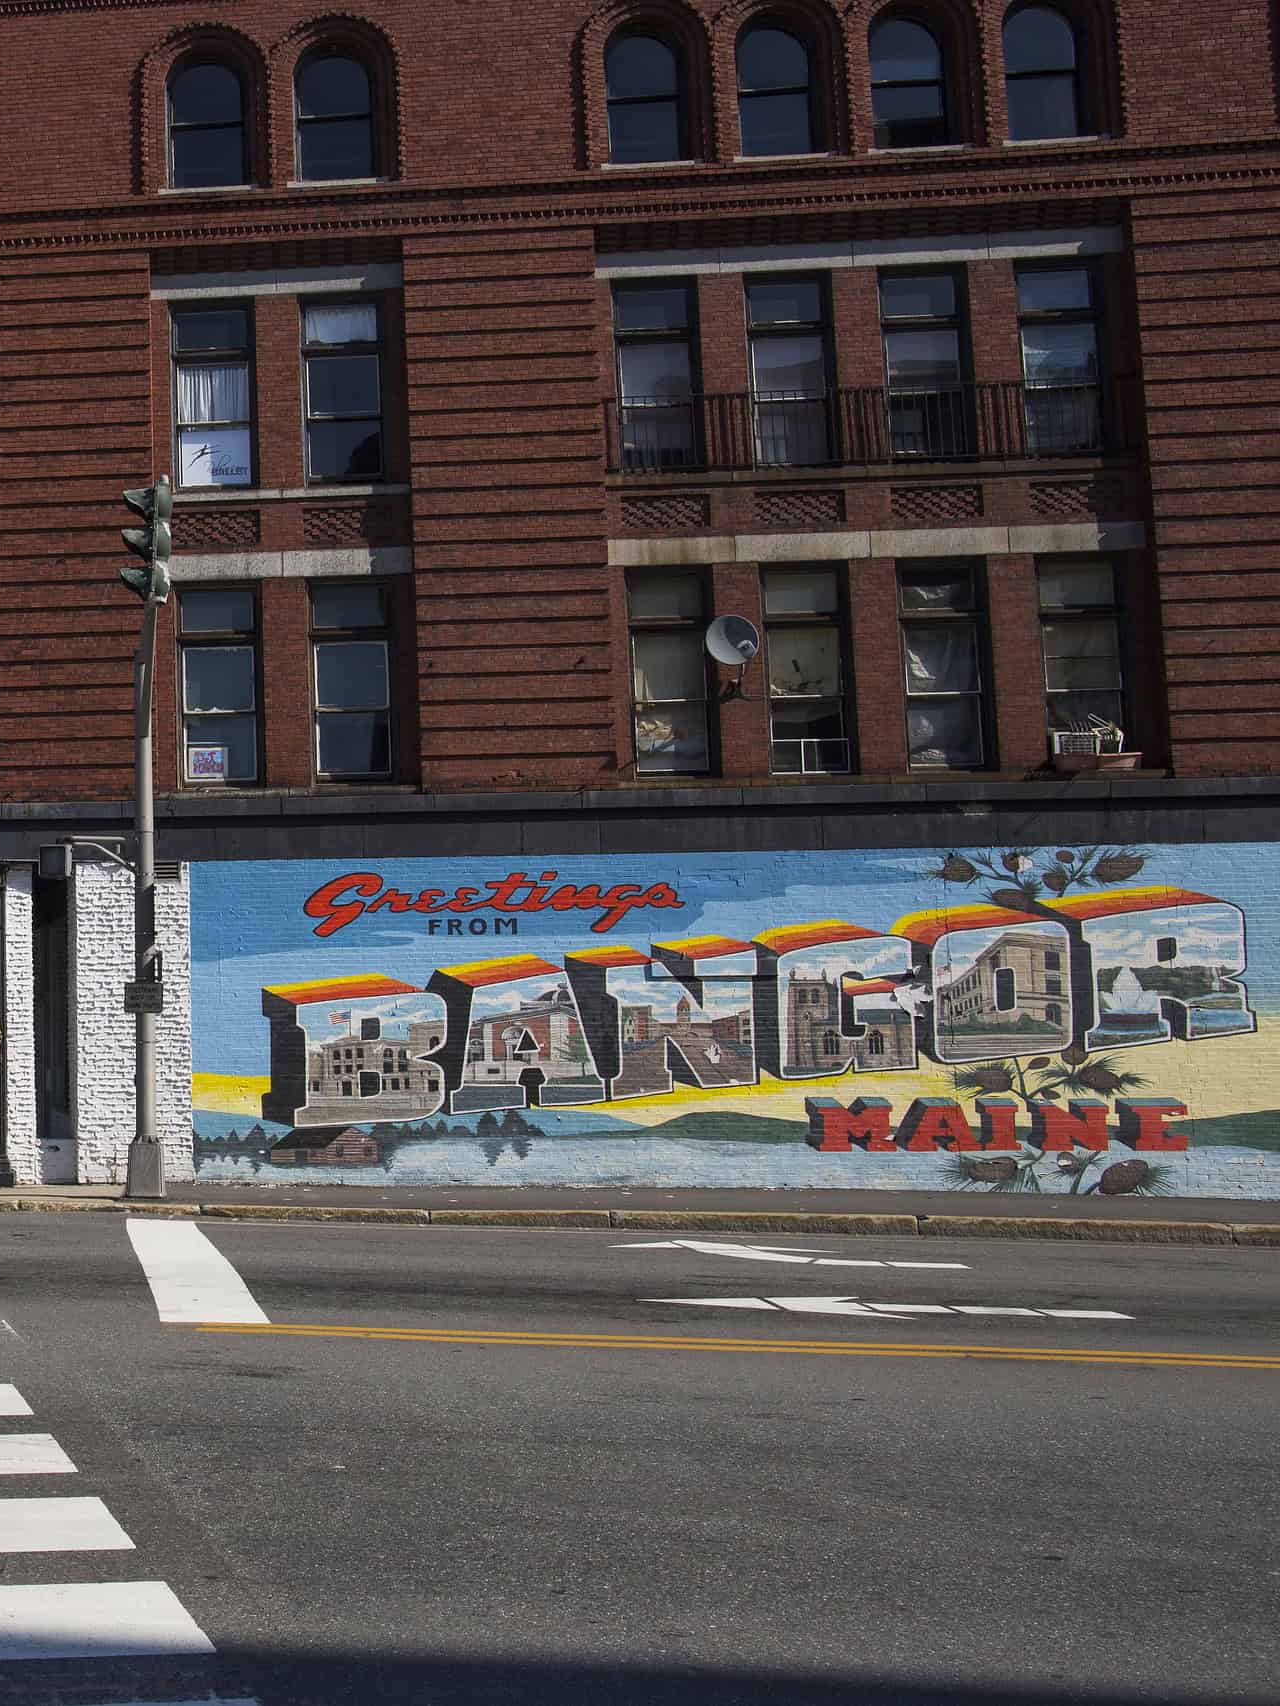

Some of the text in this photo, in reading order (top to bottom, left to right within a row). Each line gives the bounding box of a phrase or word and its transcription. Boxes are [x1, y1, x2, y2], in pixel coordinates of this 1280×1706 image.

[304, 871, 686, 937] Greetings
[427, 918, 519, 935] FROM
[262, 886, 1257, 1128] BANGOR
[805, 1097, 1190, 1152] MAINE
